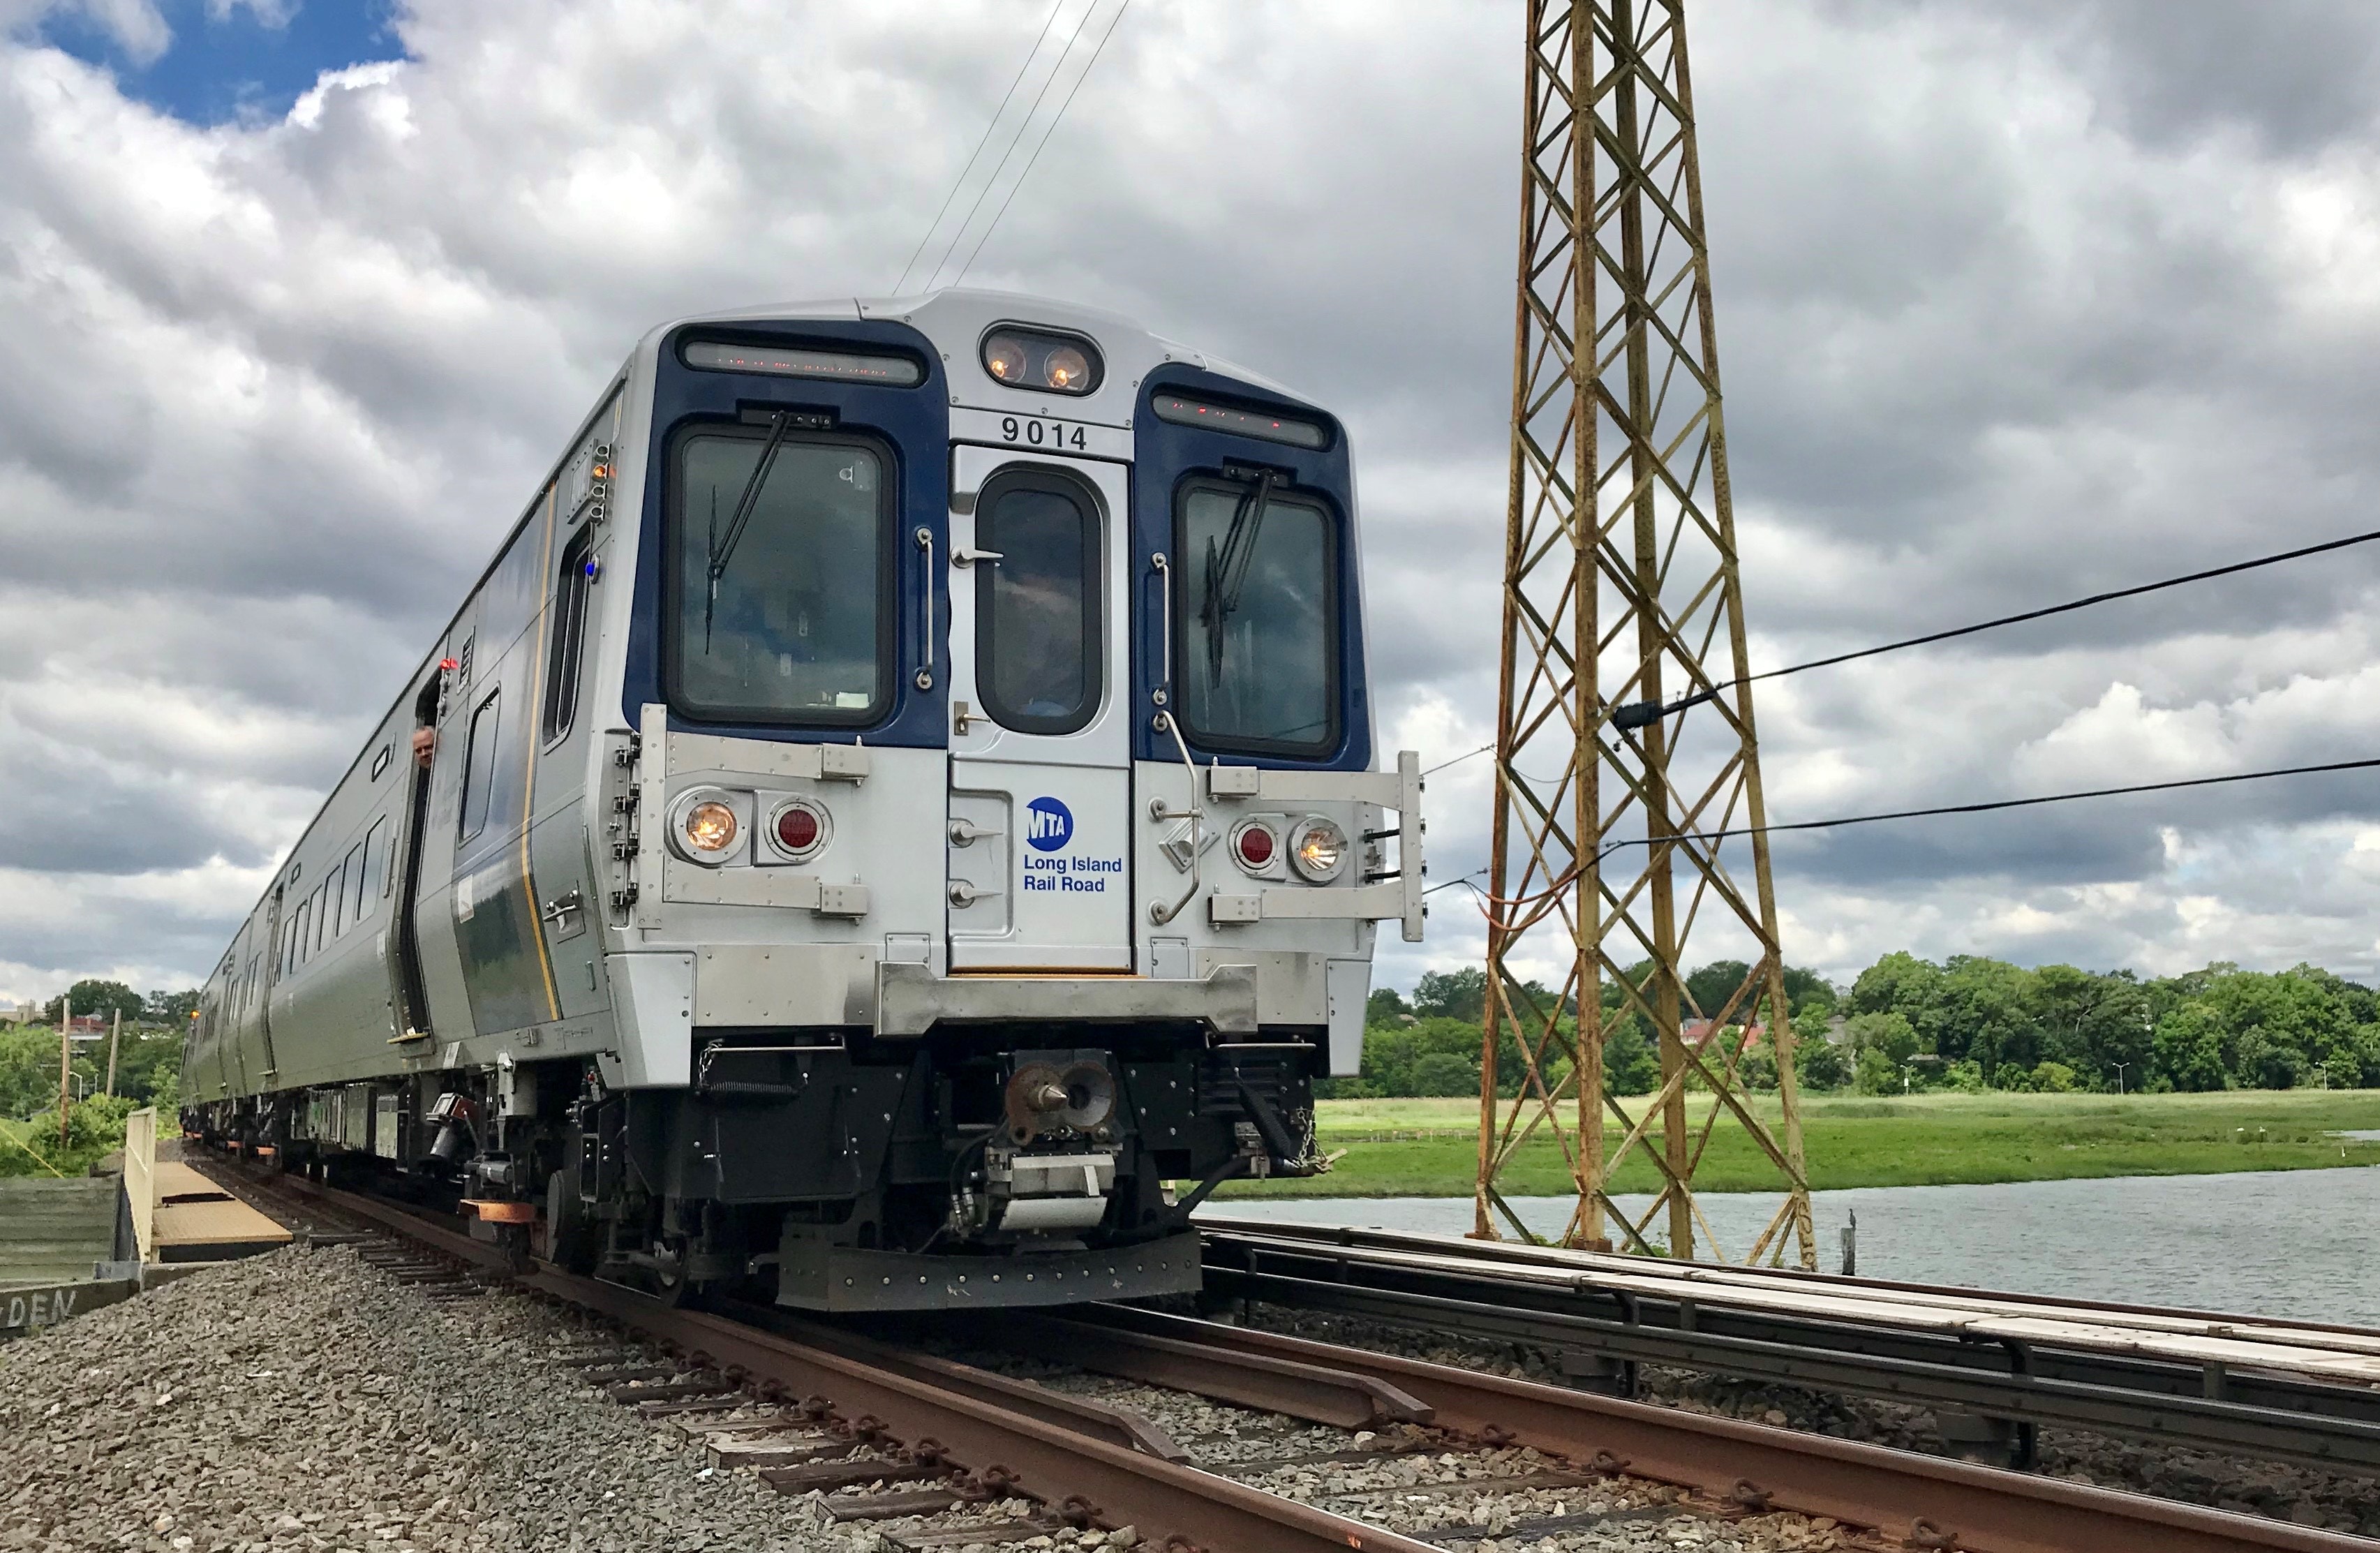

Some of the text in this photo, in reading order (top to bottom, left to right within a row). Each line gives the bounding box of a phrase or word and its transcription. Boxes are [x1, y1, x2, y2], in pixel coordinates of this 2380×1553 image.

[1002, 417, 1087, 450] 9014
[1027, 808, 1065, 840] MTA
[1024, 854, 1122, 874] Long Island
[1024, 875, 1105, 892] Rail Road
[0, 1290, 77, 1327] DEN
